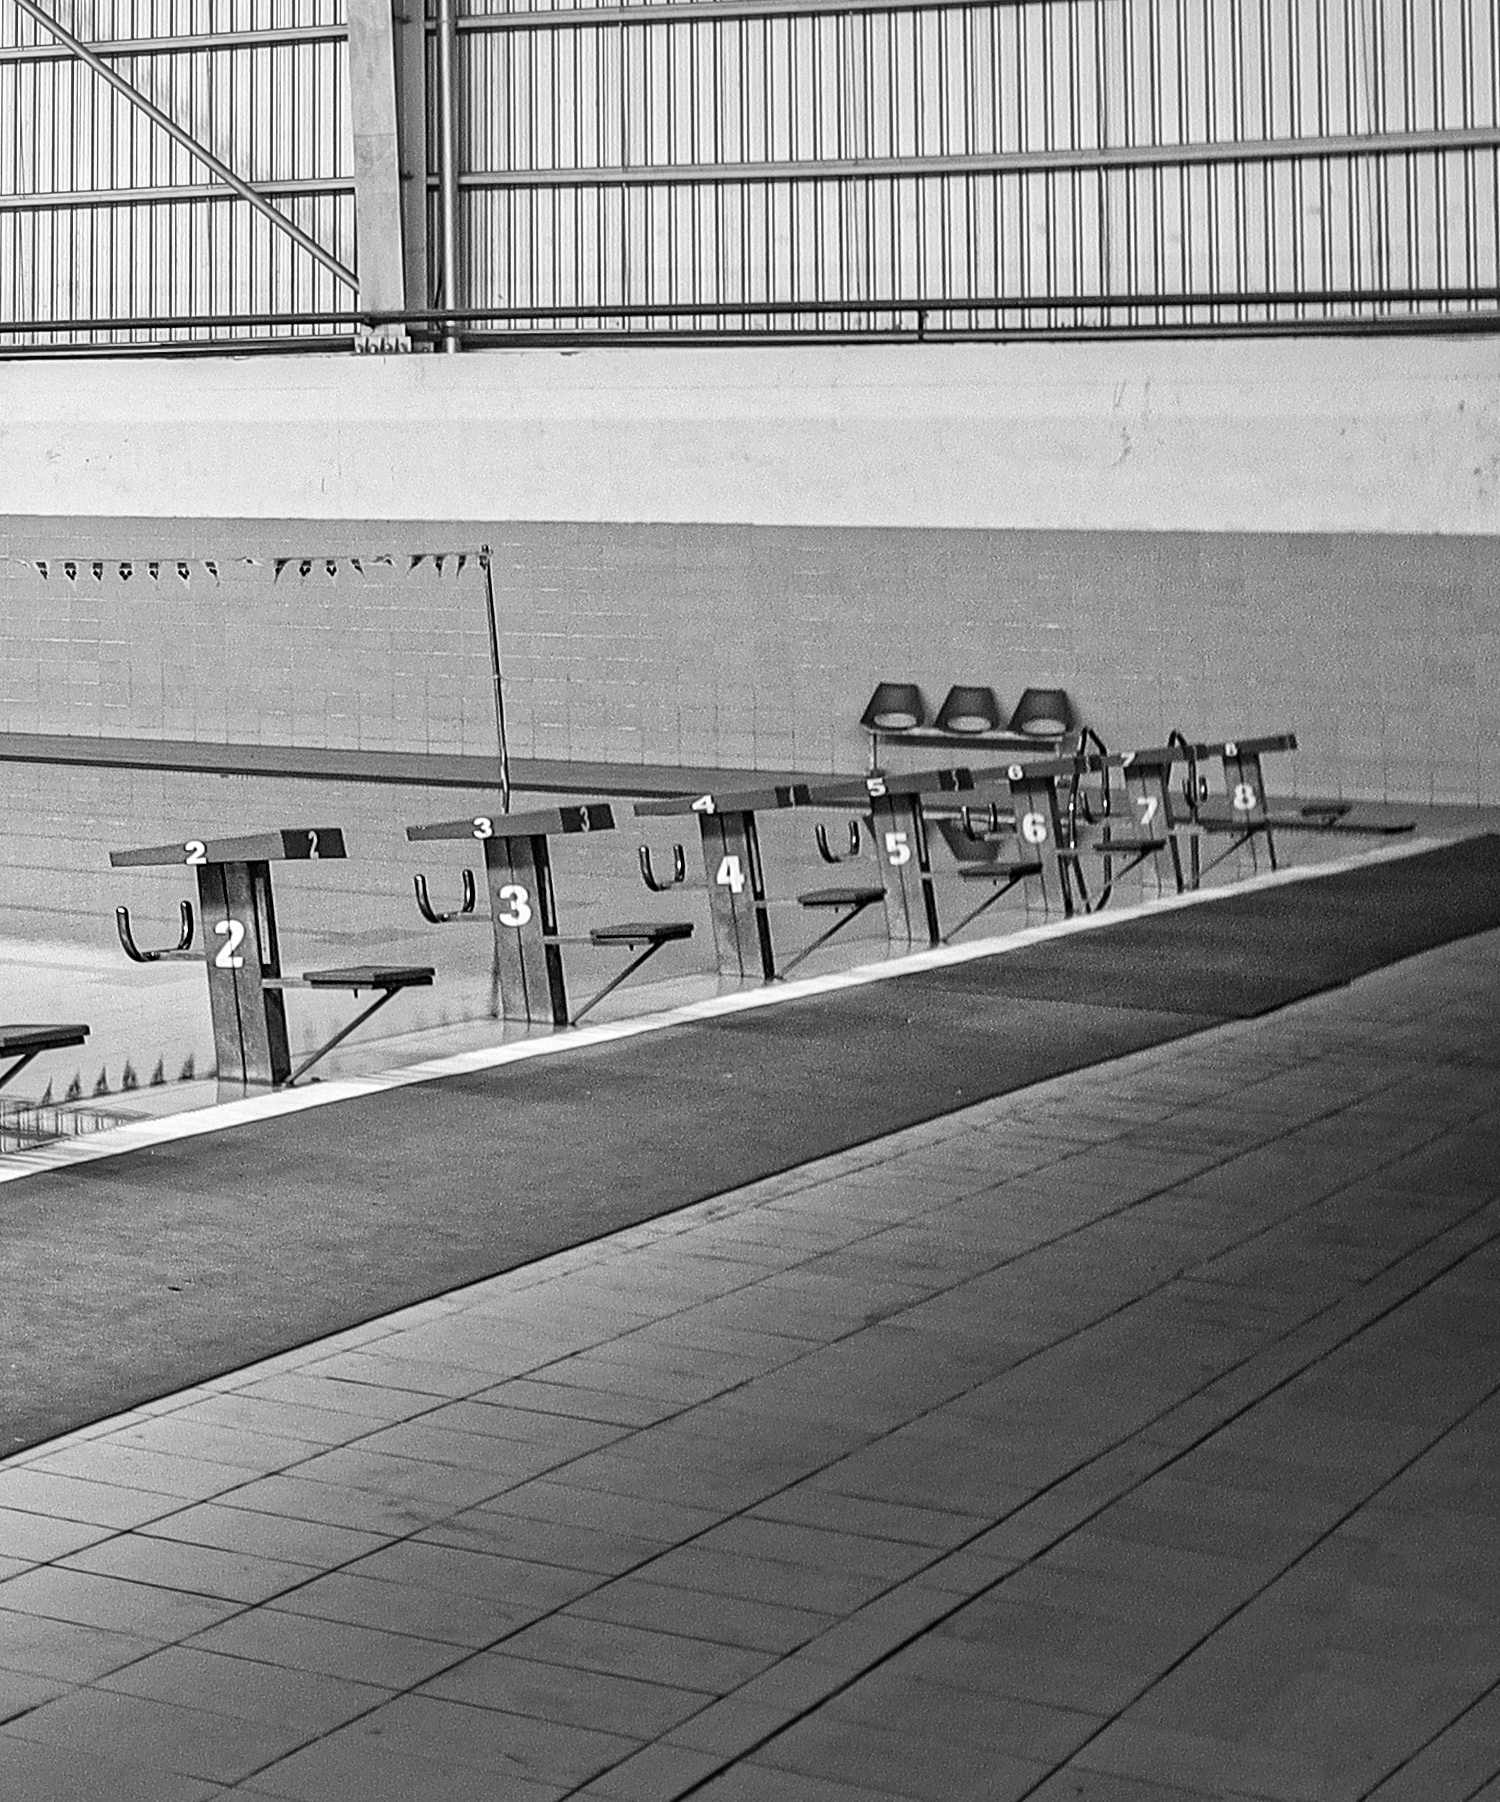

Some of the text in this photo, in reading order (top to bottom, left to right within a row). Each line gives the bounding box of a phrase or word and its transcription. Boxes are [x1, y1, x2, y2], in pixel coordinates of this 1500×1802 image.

[1121, 752, 1136, 767] 7
[866, 778, 886, 796] 5
[1234, 783, 1257, 810] 8
[691, 795, 715, 814] 4
[1137, 797, 1158, 824] 7
[473, 817, 493, 838] 3
[579, 806, 590, 833] 3
[1023, 813, 1047, 844] 6
[184, 841, 207, 864] 2
[308, 830, 319, 859] 2
[885, 832, 911, 866] 5
[717, 855, 745, 893] 4
[499, 885, 532, 927] 3
[215, 919, 244, 968] 2
